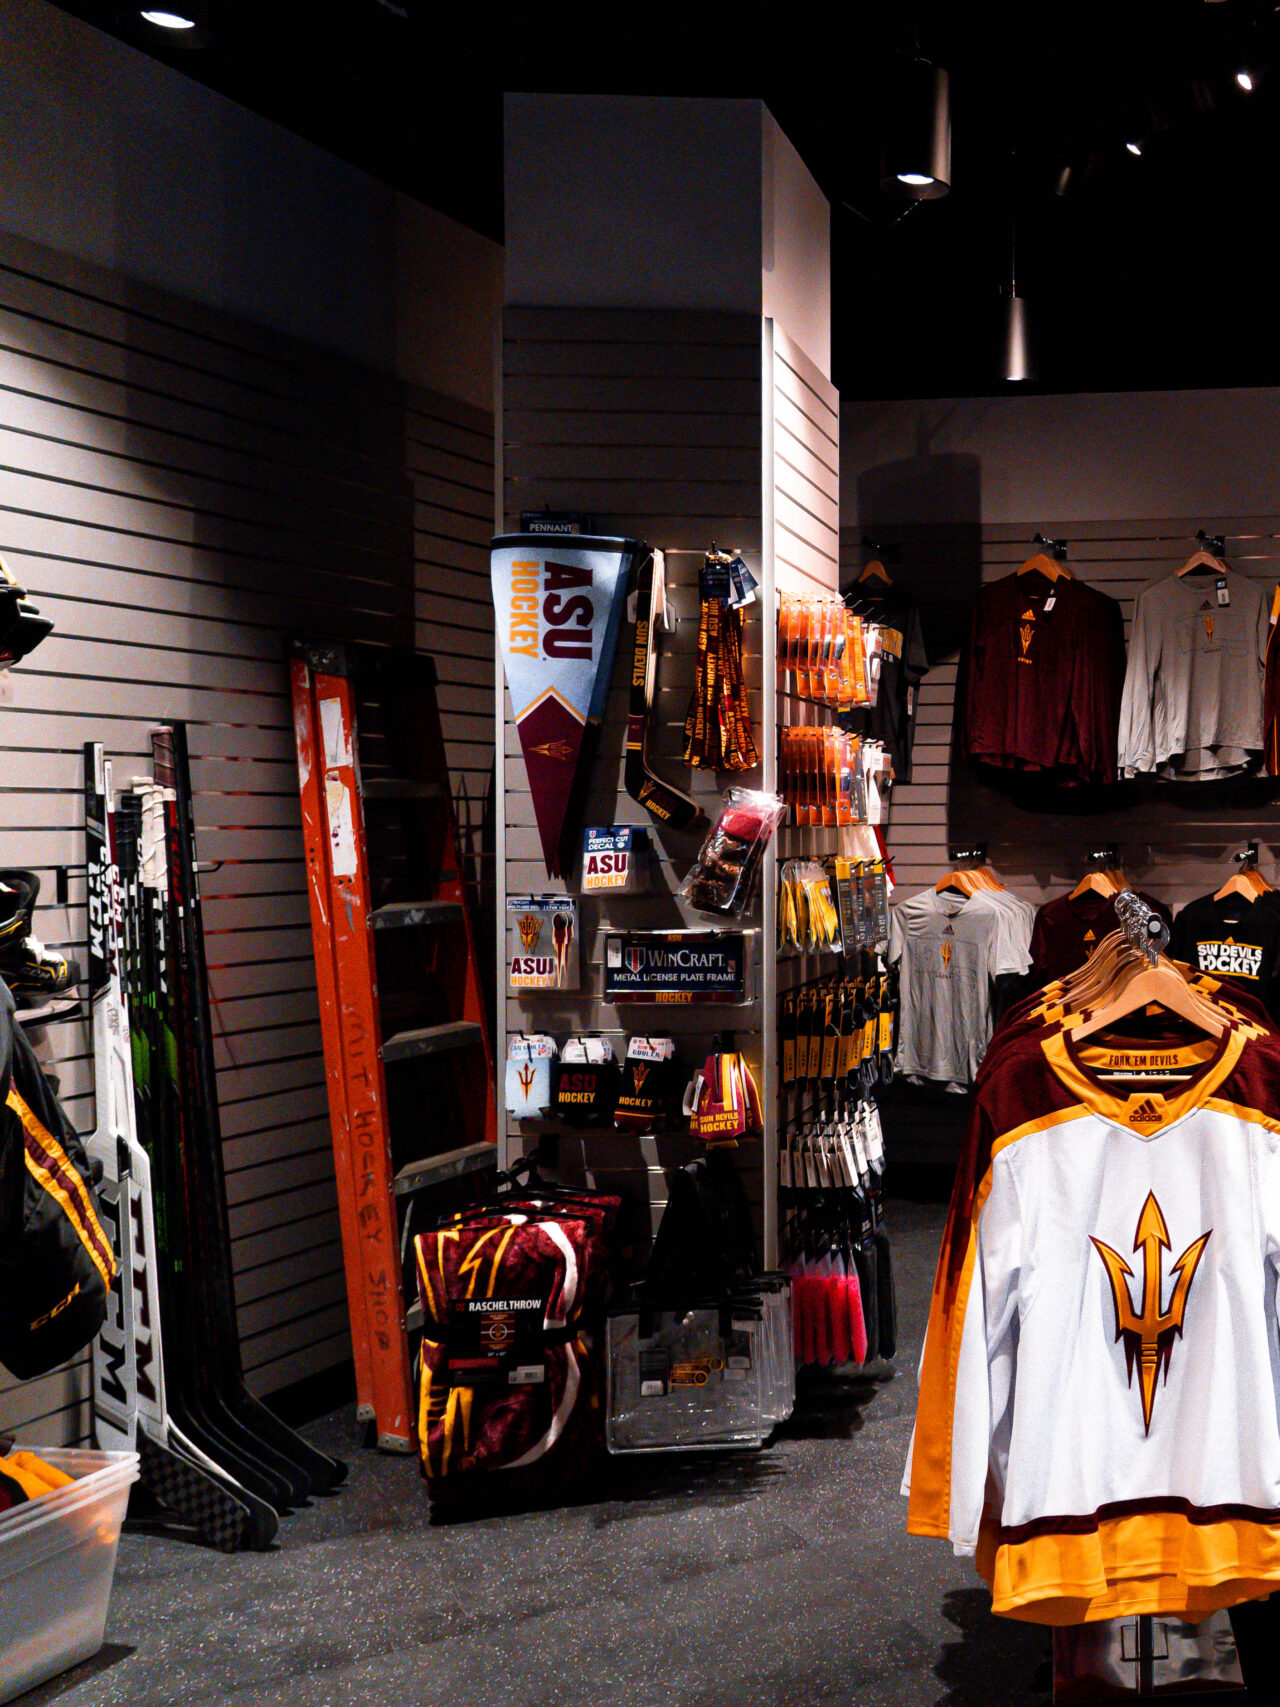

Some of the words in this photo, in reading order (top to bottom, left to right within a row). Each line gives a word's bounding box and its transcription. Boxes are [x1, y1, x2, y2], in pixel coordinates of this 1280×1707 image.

[529, 523, 572, 533] PENNANT
[509, 560, 540, 659] HOCKEY
[543, 560, 595, 662] ASU
[635, 620, 649, 645] SUN
[632, 649, 647, 687] DEVILS
[645, 799, 672, 821] HOCKEY
[588, 843, 614, 851] DECAL
[587, 854, 628, 875] ASU
[586, 874, 627, 888] HOCKEY
[1220, 944, 1263, 961] DEVILS
[511, 957, 547, 975] ASU
[1198, 955, 1261, 976] HOCKEY
[510, 976, 547, 987] HOCKEY
[613, 973, 642, 982] METAL
[643, 973, 678, 982] LICENSE
[680, 973, 705, 982] PLATE
[707, 973, 736, 981] FRAME
[655, 992, 693, 1003] HOCKEY
[1109, 1054, 1131, 1067] FORK
[1150, 1054, 1179, 1067] DEVILS
[560, 1073, 597, 1092] ASU
[558, 1091, 596, 1104] HOCKEY
[618, 1096, 653, 1108] HOCKEY
[700, 1113, 714, 1123] SUN
[715, 1111, 739, 1121] DEVILS
[1129, 1114, 1163, 1123] adidas
[700, 1120, 739, 1134] HOCKEY
[468, 1301, 508, 1312] RASCHEL
[509, 1299, 542, 1310] THROW
